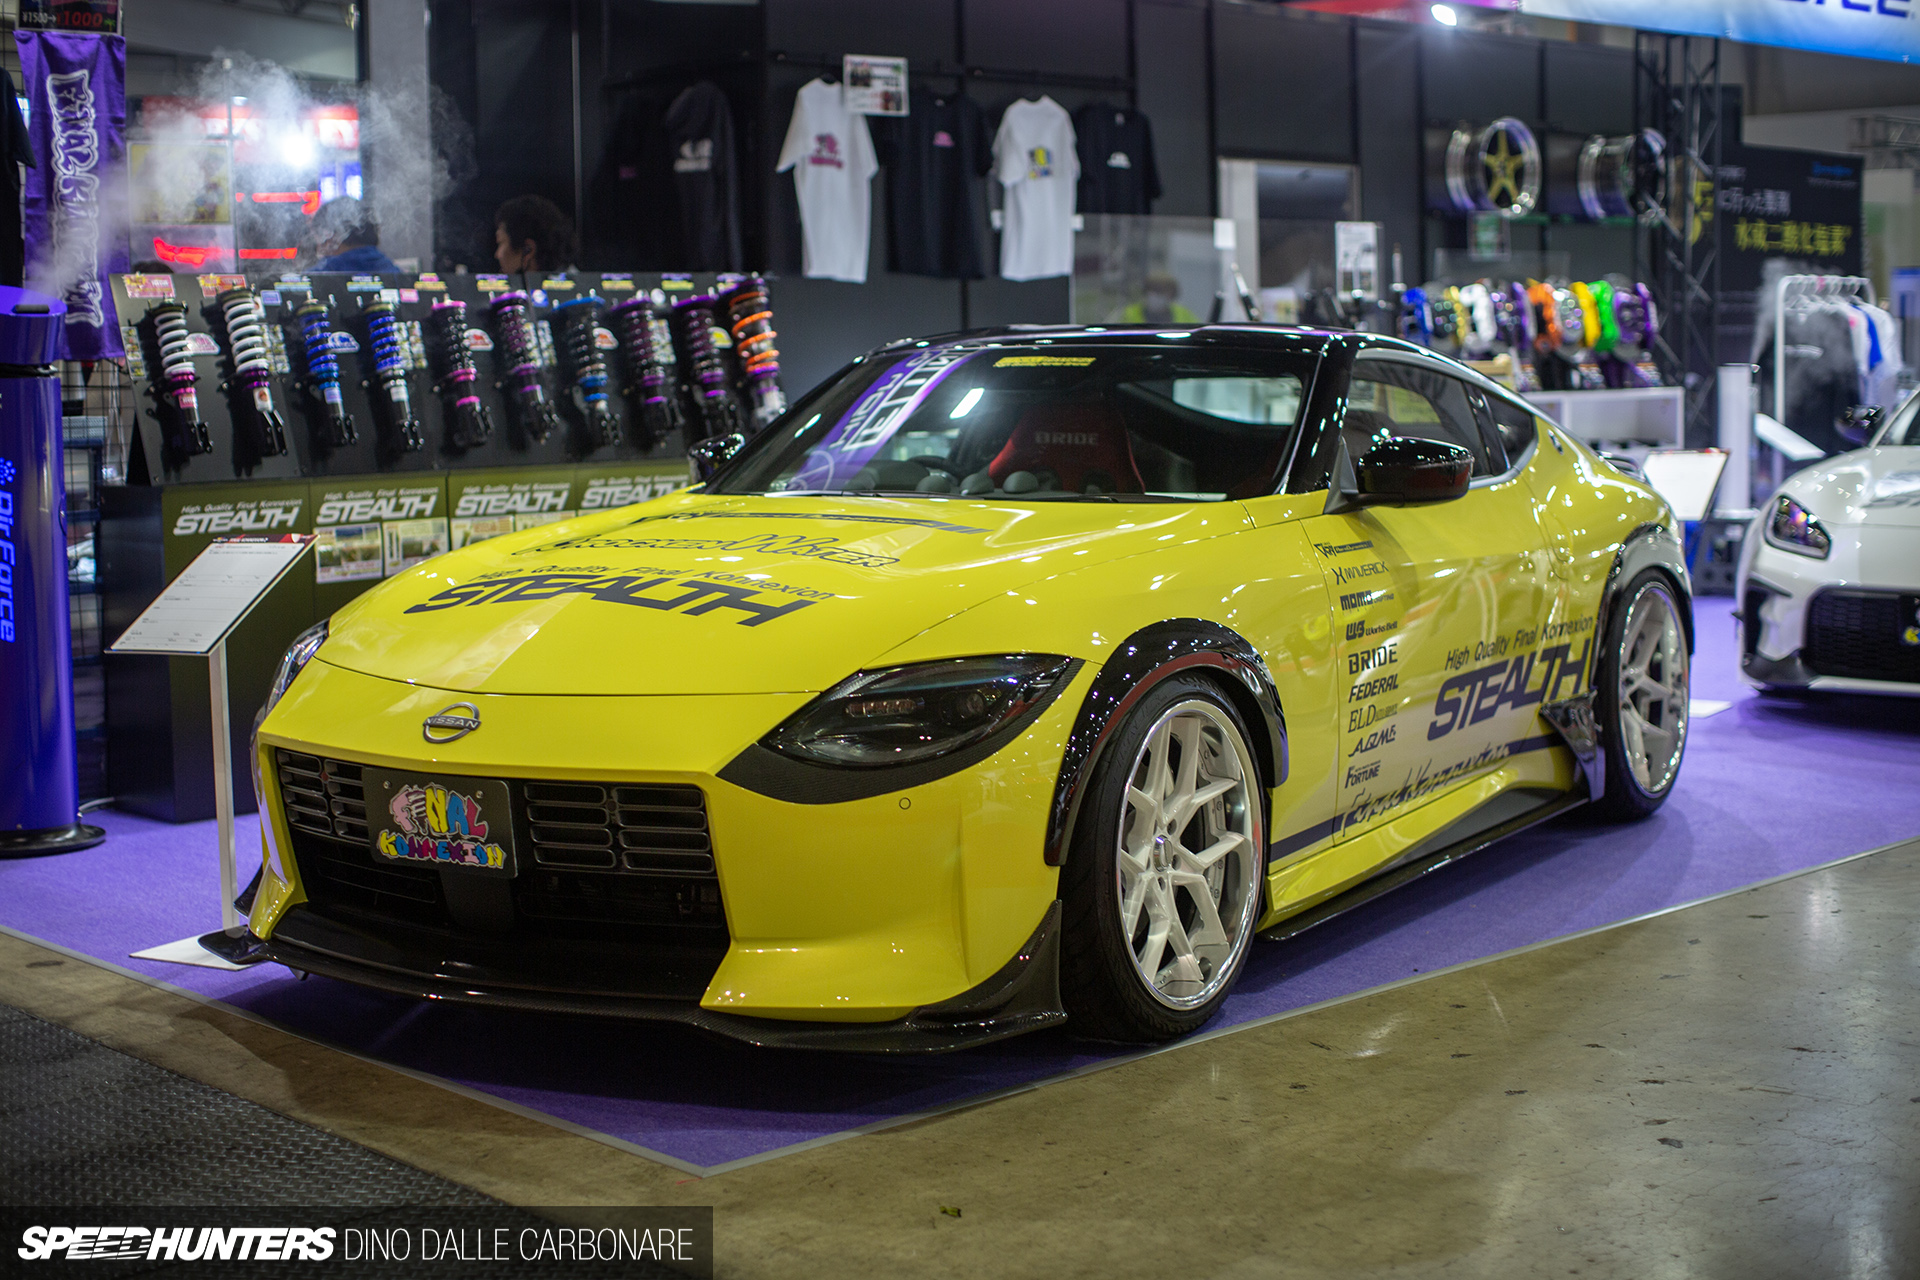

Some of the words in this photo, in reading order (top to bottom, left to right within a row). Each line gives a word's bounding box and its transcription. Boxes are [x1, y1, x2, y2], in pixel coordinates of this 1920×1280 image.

[1035, 431, 1098, 445] BRIDE
[316, 495, 437, 524] STEALTH
[455, 490, 569, 516] STEALTH
[173, 507, 300, 536] STEALTH
[622, 566, 693, 577] Final
[698, 570, 837, 600] Konnexion
[403, 574, 819, 627] STEALTH
[1445, 646, 1469, 671] High
[1475, 636, 1510, 662] Quality
[1513, 624, 1539, 649] Final
[1541, 614, 1593, 641] Konnexion
[1348, 643, 1398, 675] BRIDE
[1348, 673, 1399, 703] FEDERAL
[1427, 637, 1591, 741] STEALTH
[425, 717, 478, 729] NISSAN
[1345, 765, 1380, 789] FORTUNE
[378, 829, 507, 869] KONNEXION
